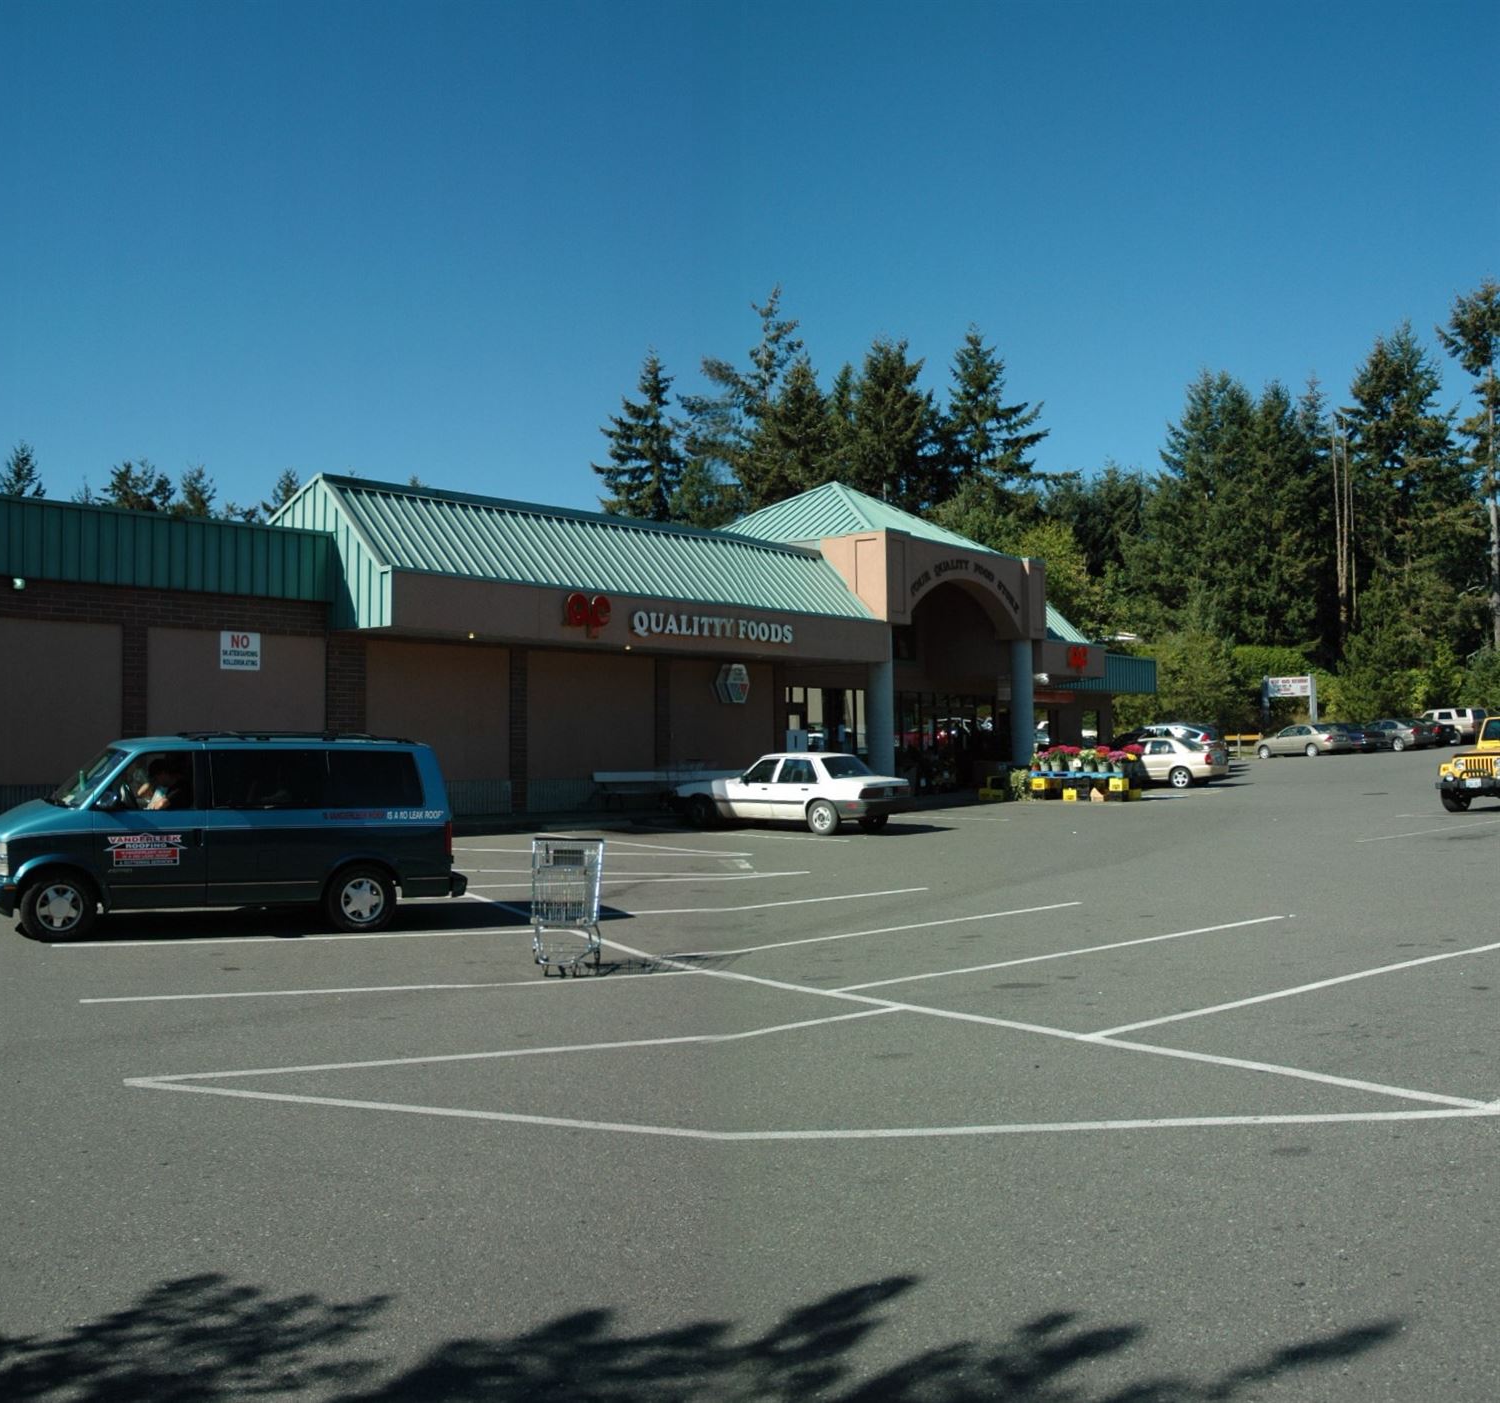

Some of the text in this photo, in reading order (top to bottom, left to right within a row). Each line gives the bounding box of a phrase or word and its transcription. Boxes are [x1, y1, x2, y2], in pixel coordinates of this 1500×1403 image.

[934, 559, 970, 577] QUALITY
[973, 562, 995, 583] FOOD
[738, 620, 794, 644] FOODS
[231, 634, 251, 649] NO
[409, 810, 423, 819] LEAK
[110, 835, 180, 844] VANDERLEEK
